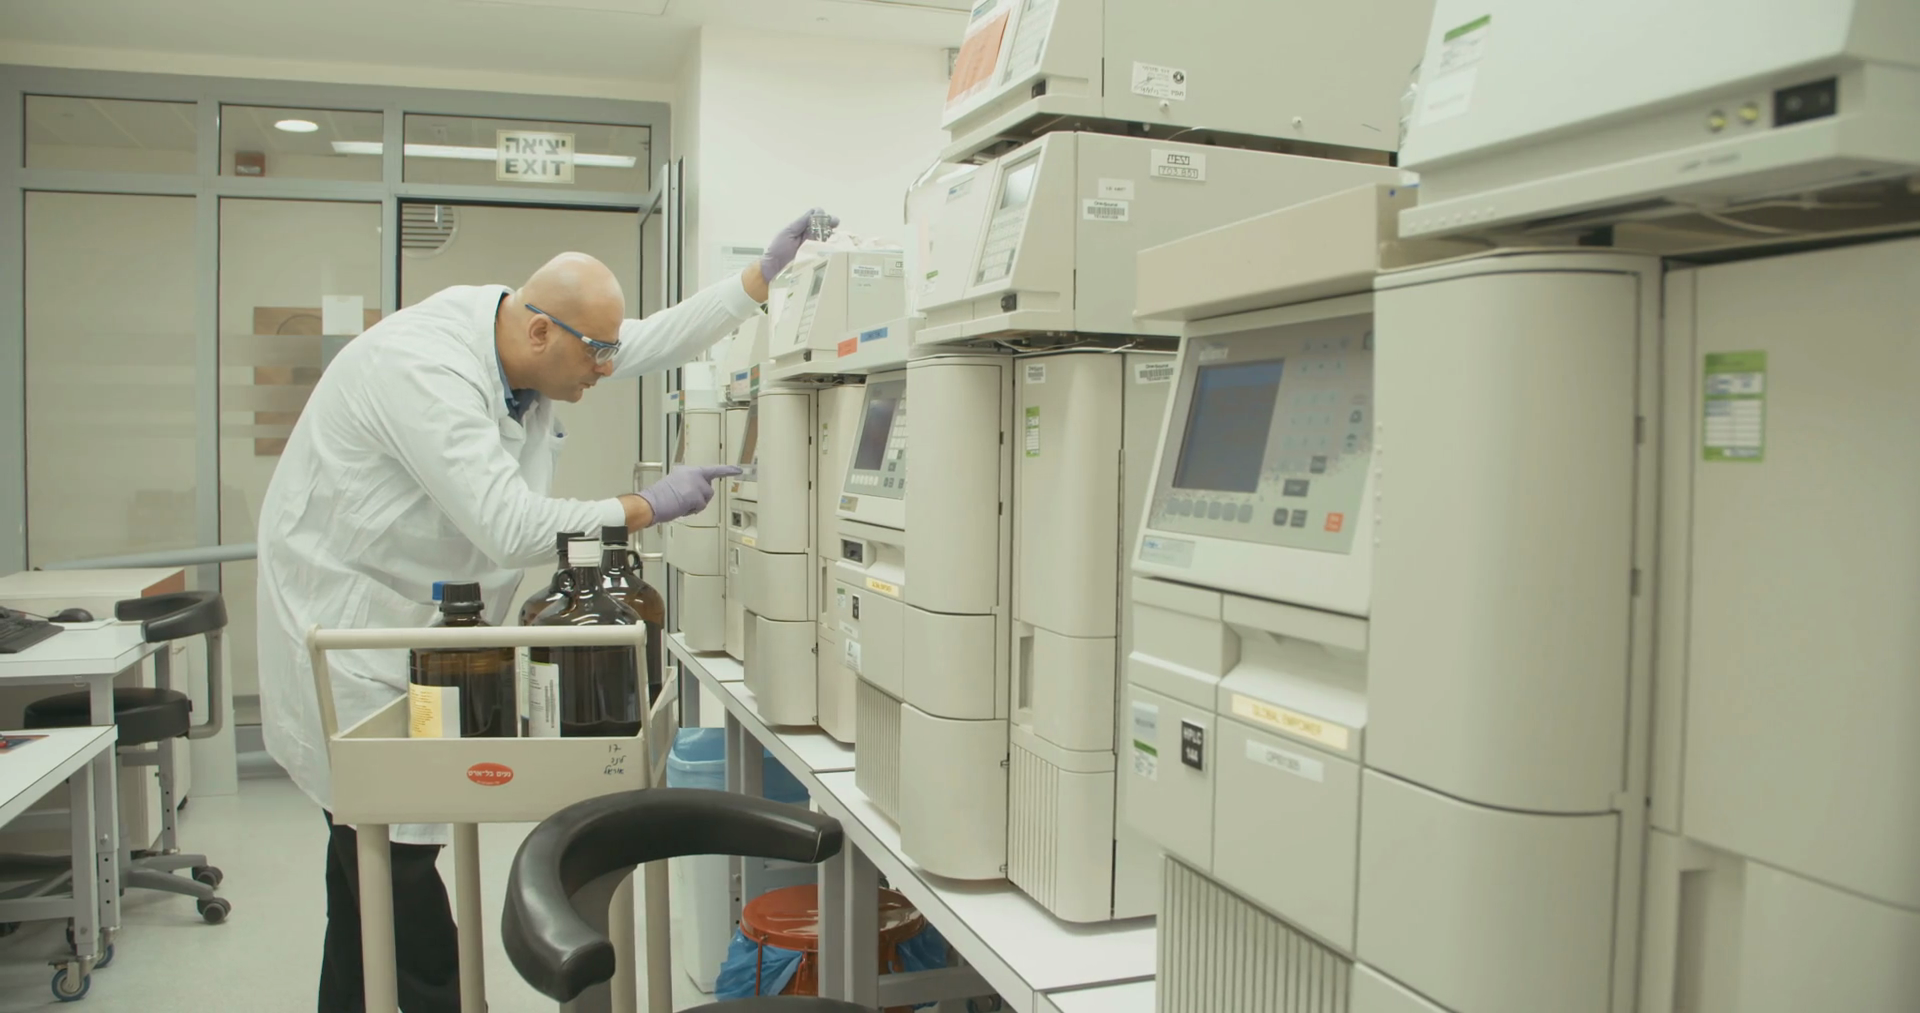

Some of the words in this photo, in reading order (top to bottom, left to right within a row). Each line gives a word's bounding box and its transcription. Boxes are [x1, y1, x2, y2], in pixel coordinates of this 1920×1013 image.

[505, 137, 566, 155] יציאה
[505, 158, 566, 176] EXIT
[1182, 727, 1202, 745] HPLC
